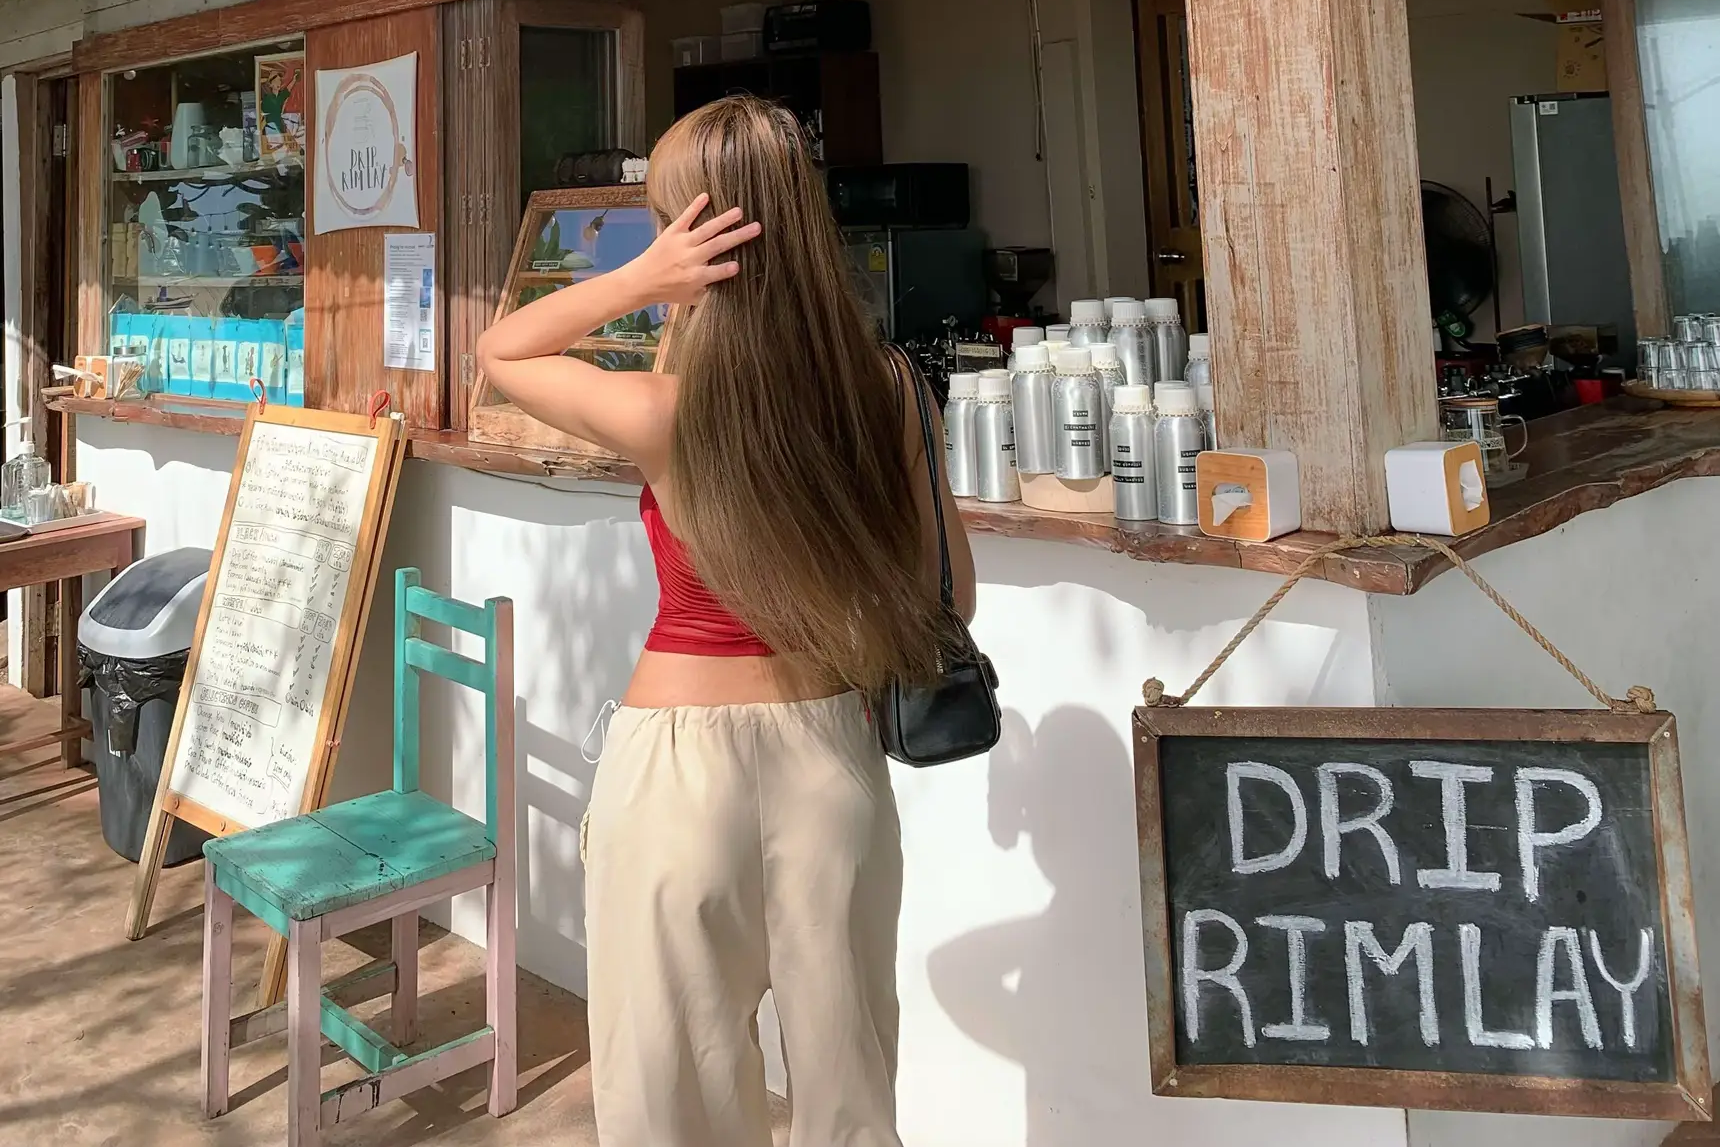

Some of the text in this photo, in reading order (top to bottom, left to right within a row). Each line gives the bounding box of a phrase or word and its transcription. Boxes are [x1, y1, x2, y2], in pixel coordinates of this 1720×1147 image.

[341, 164, 386, 192] RIMLAY
[351, 146, 377, 171] DRIP
[1227, 760, 1602, 903] DRIP
[1182, 909, 1654, 1050] RIMLAY
